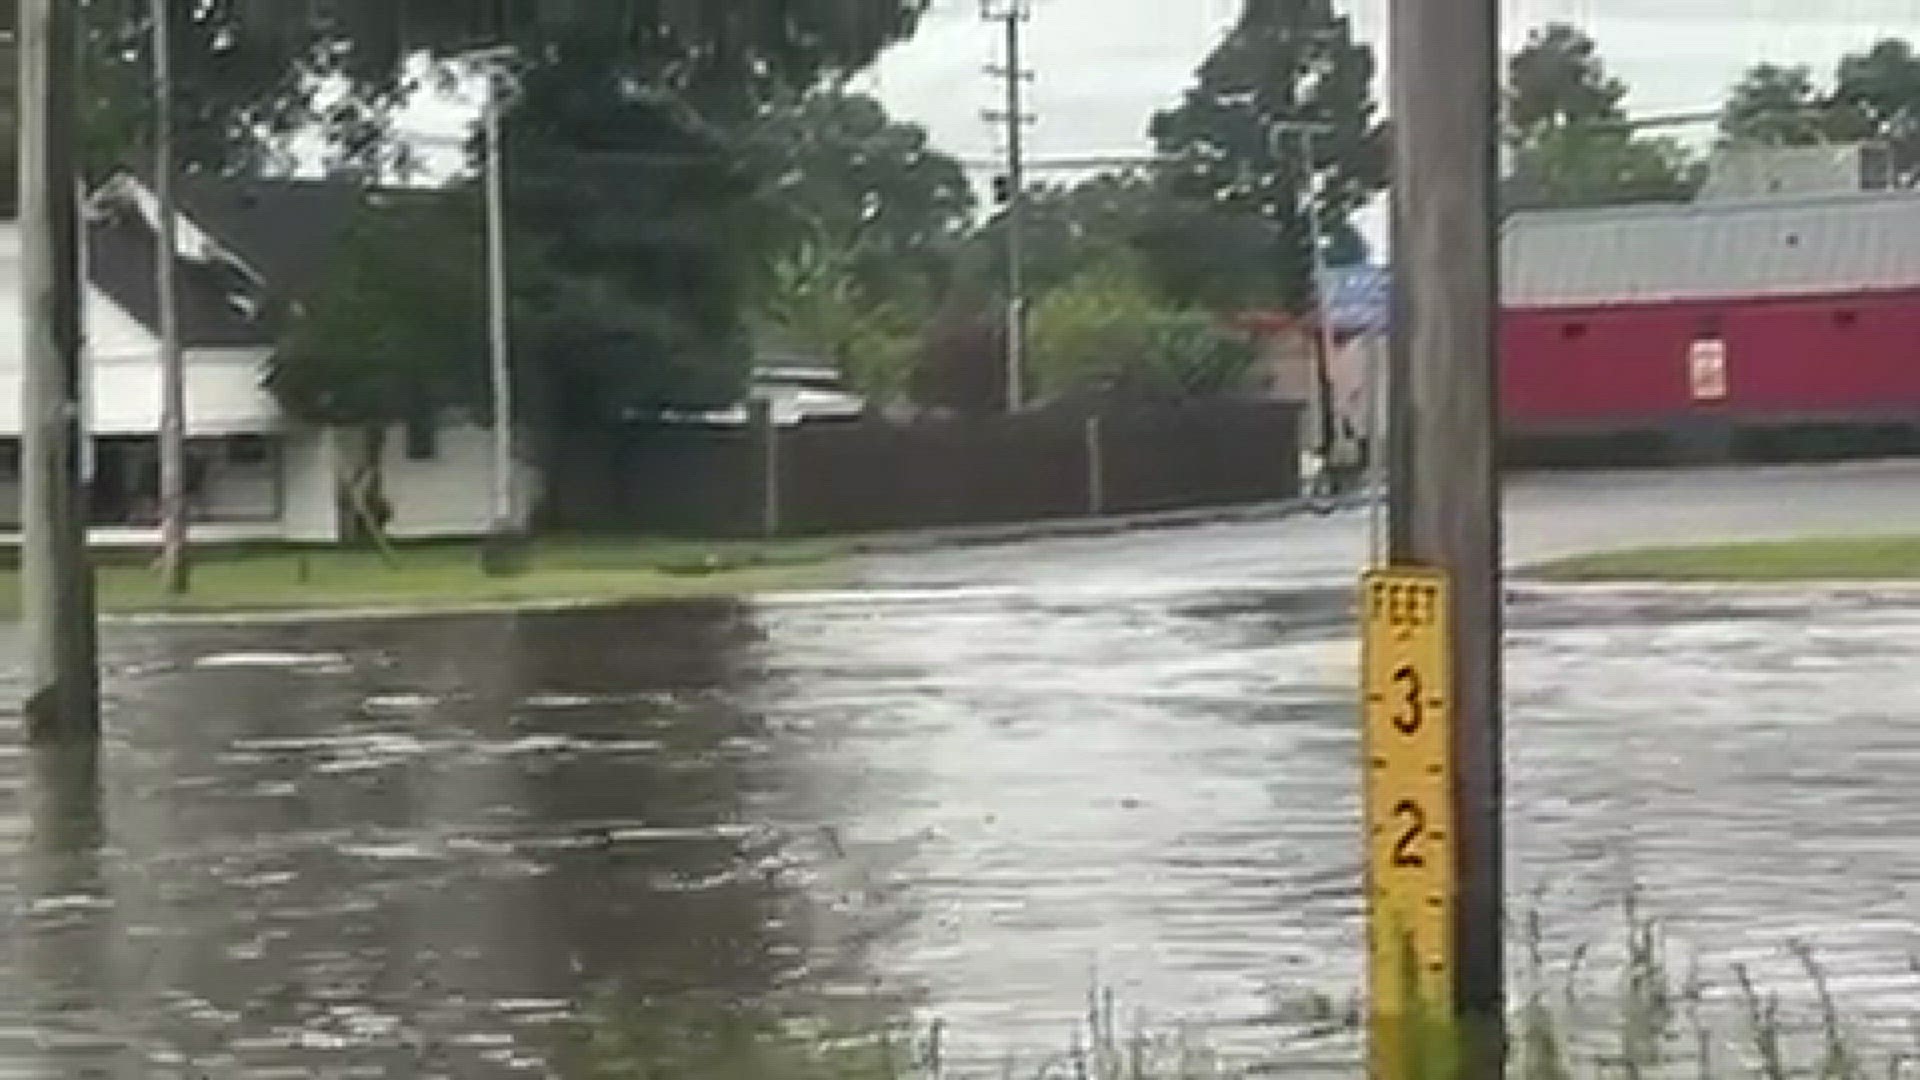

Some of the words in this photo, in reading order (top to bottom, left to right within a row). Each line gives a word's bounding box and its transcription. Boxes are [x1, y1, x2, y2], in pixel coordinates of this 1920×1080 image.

[1371, 581, 1438, 625] FEET
[1392, 665, 1423, 735] 3
[1391, 800, 1426, 867] 2
